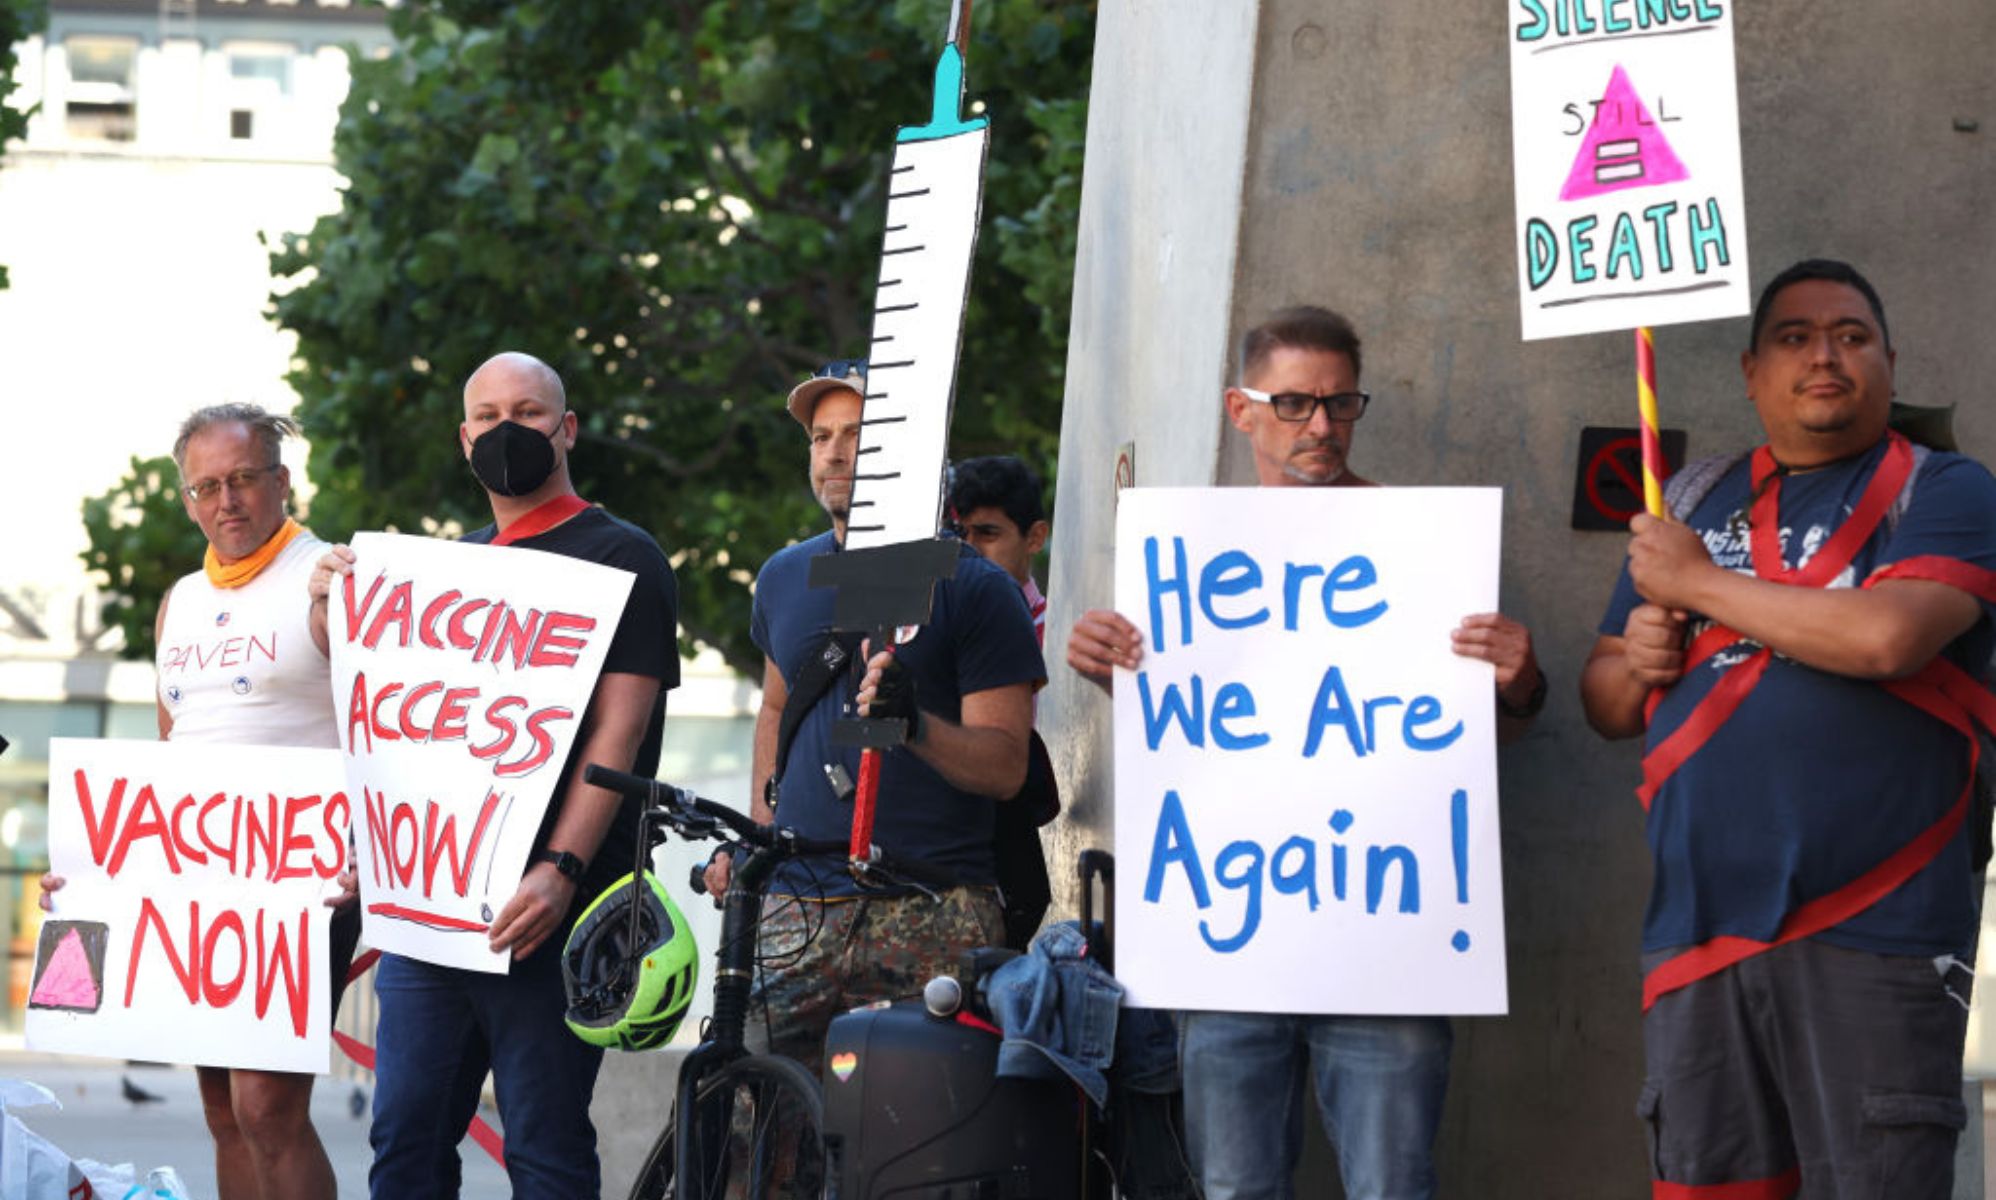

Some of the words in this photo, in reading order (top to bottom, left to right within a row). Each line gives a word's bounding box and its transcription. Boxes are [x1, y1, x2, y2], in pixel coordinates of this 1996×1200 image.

[1562, 96, 1682, 136] STILL
[1526, 197, 1731, 291] DEATH
[341, 568, 598, 672] VACCINE
[1144, 536, 1389, 653] Here
[348, 670, 574, 779] ACCESS
[1137, 672, 1270, 751] We
[1302, 666, 1464, 758] Are
[74, 768, 351, 884] VACCINES
[1143, 789, 1471, 953] Again!
[123, 897, 310, 1040] NOW
